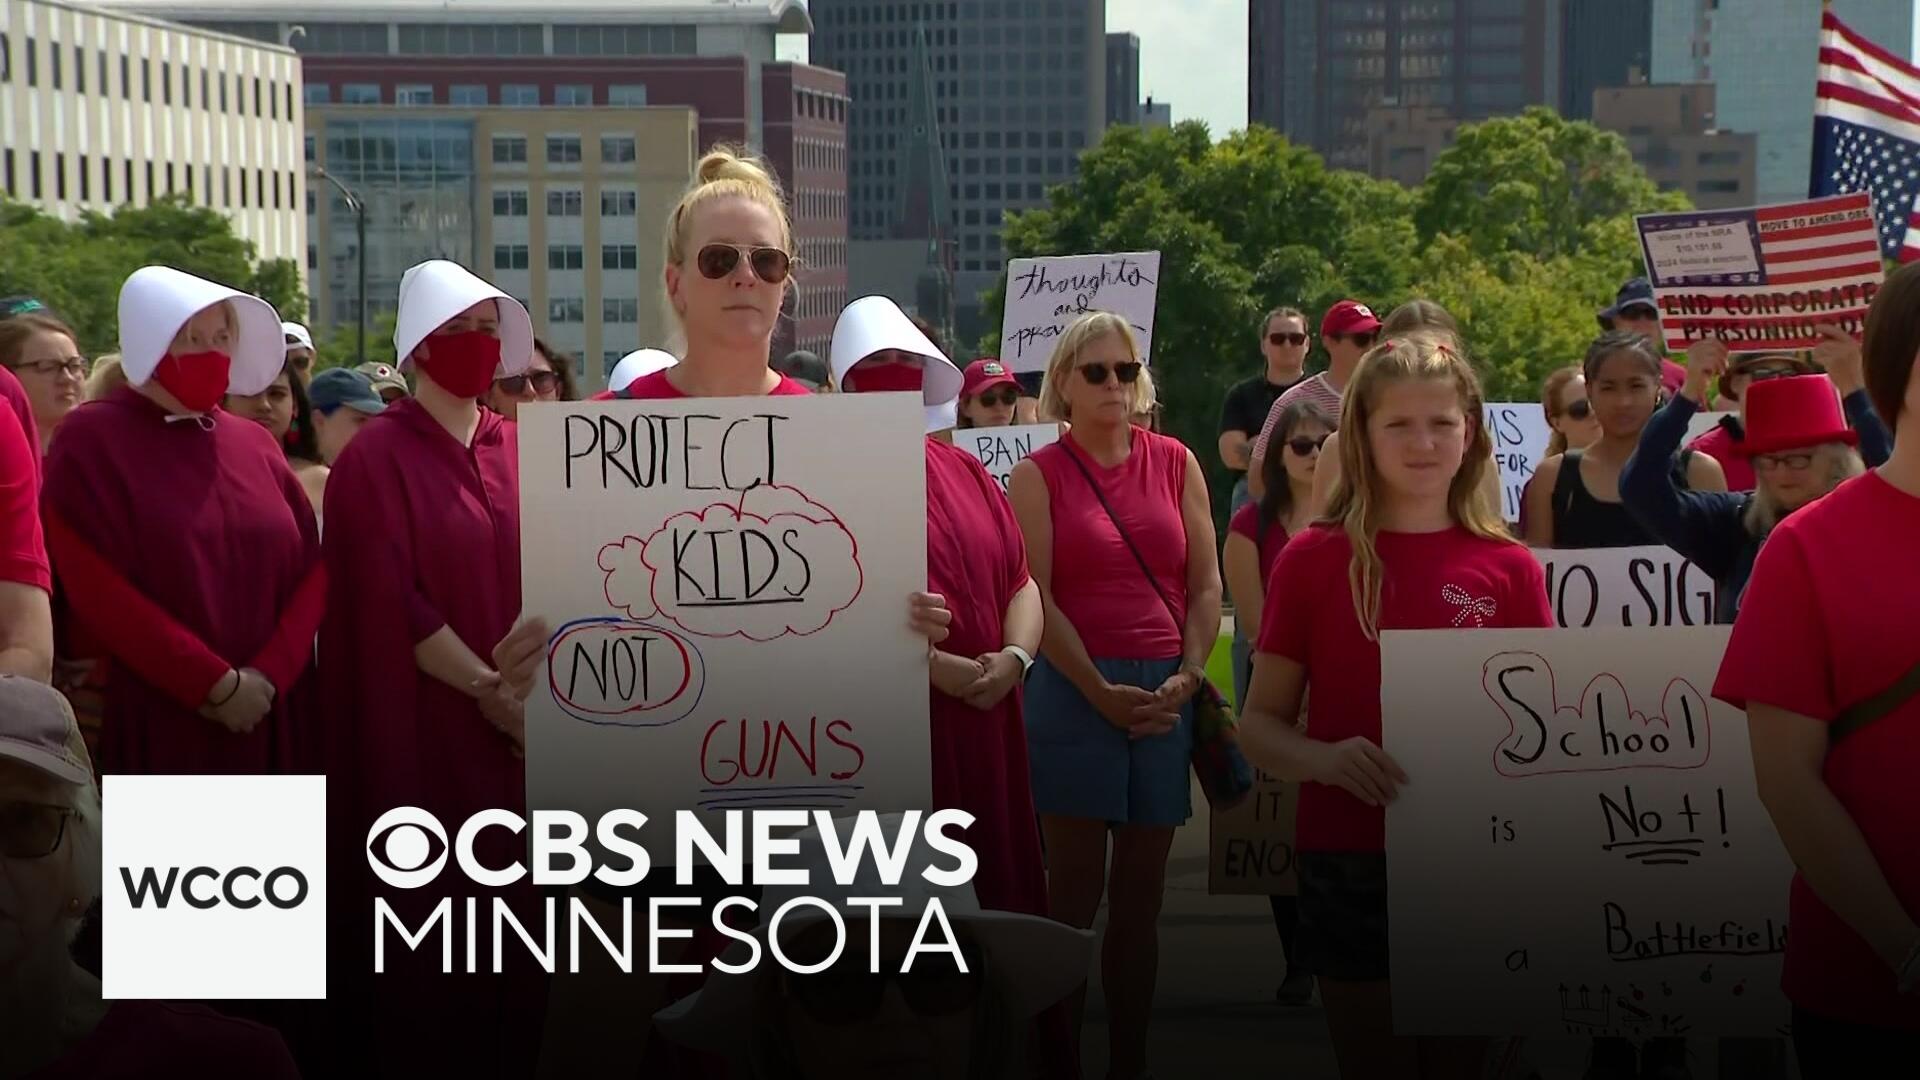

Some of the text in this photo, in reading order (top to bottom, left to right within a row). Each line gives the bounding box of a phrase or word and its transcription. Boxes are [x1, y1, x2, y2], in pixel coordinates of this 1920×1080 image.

[1760, 220, 1788, 232] MOVE
[1793, 218, 1806, 228] TO
[1014, 259, 1154, 301] thoughts
[1054, 293, 1097, 318] and
[1666, 293, 1713, 316] END
[565, 415, 789, 491] PROTECT
[977, 433, 1031, 467] BAN
[1495, 454, 1535, 477] FOR
[673, 527, 811, 602] KIDS
[568, 636, 659, 701] NOT
[1498, 666, 1696, 764] School
[701, 717, 865, 785] GUNS
[1256, 792, 1283, 822] IT
[1491, 815, 1516, 844] is
[1504, 949, 1529, 972] a
